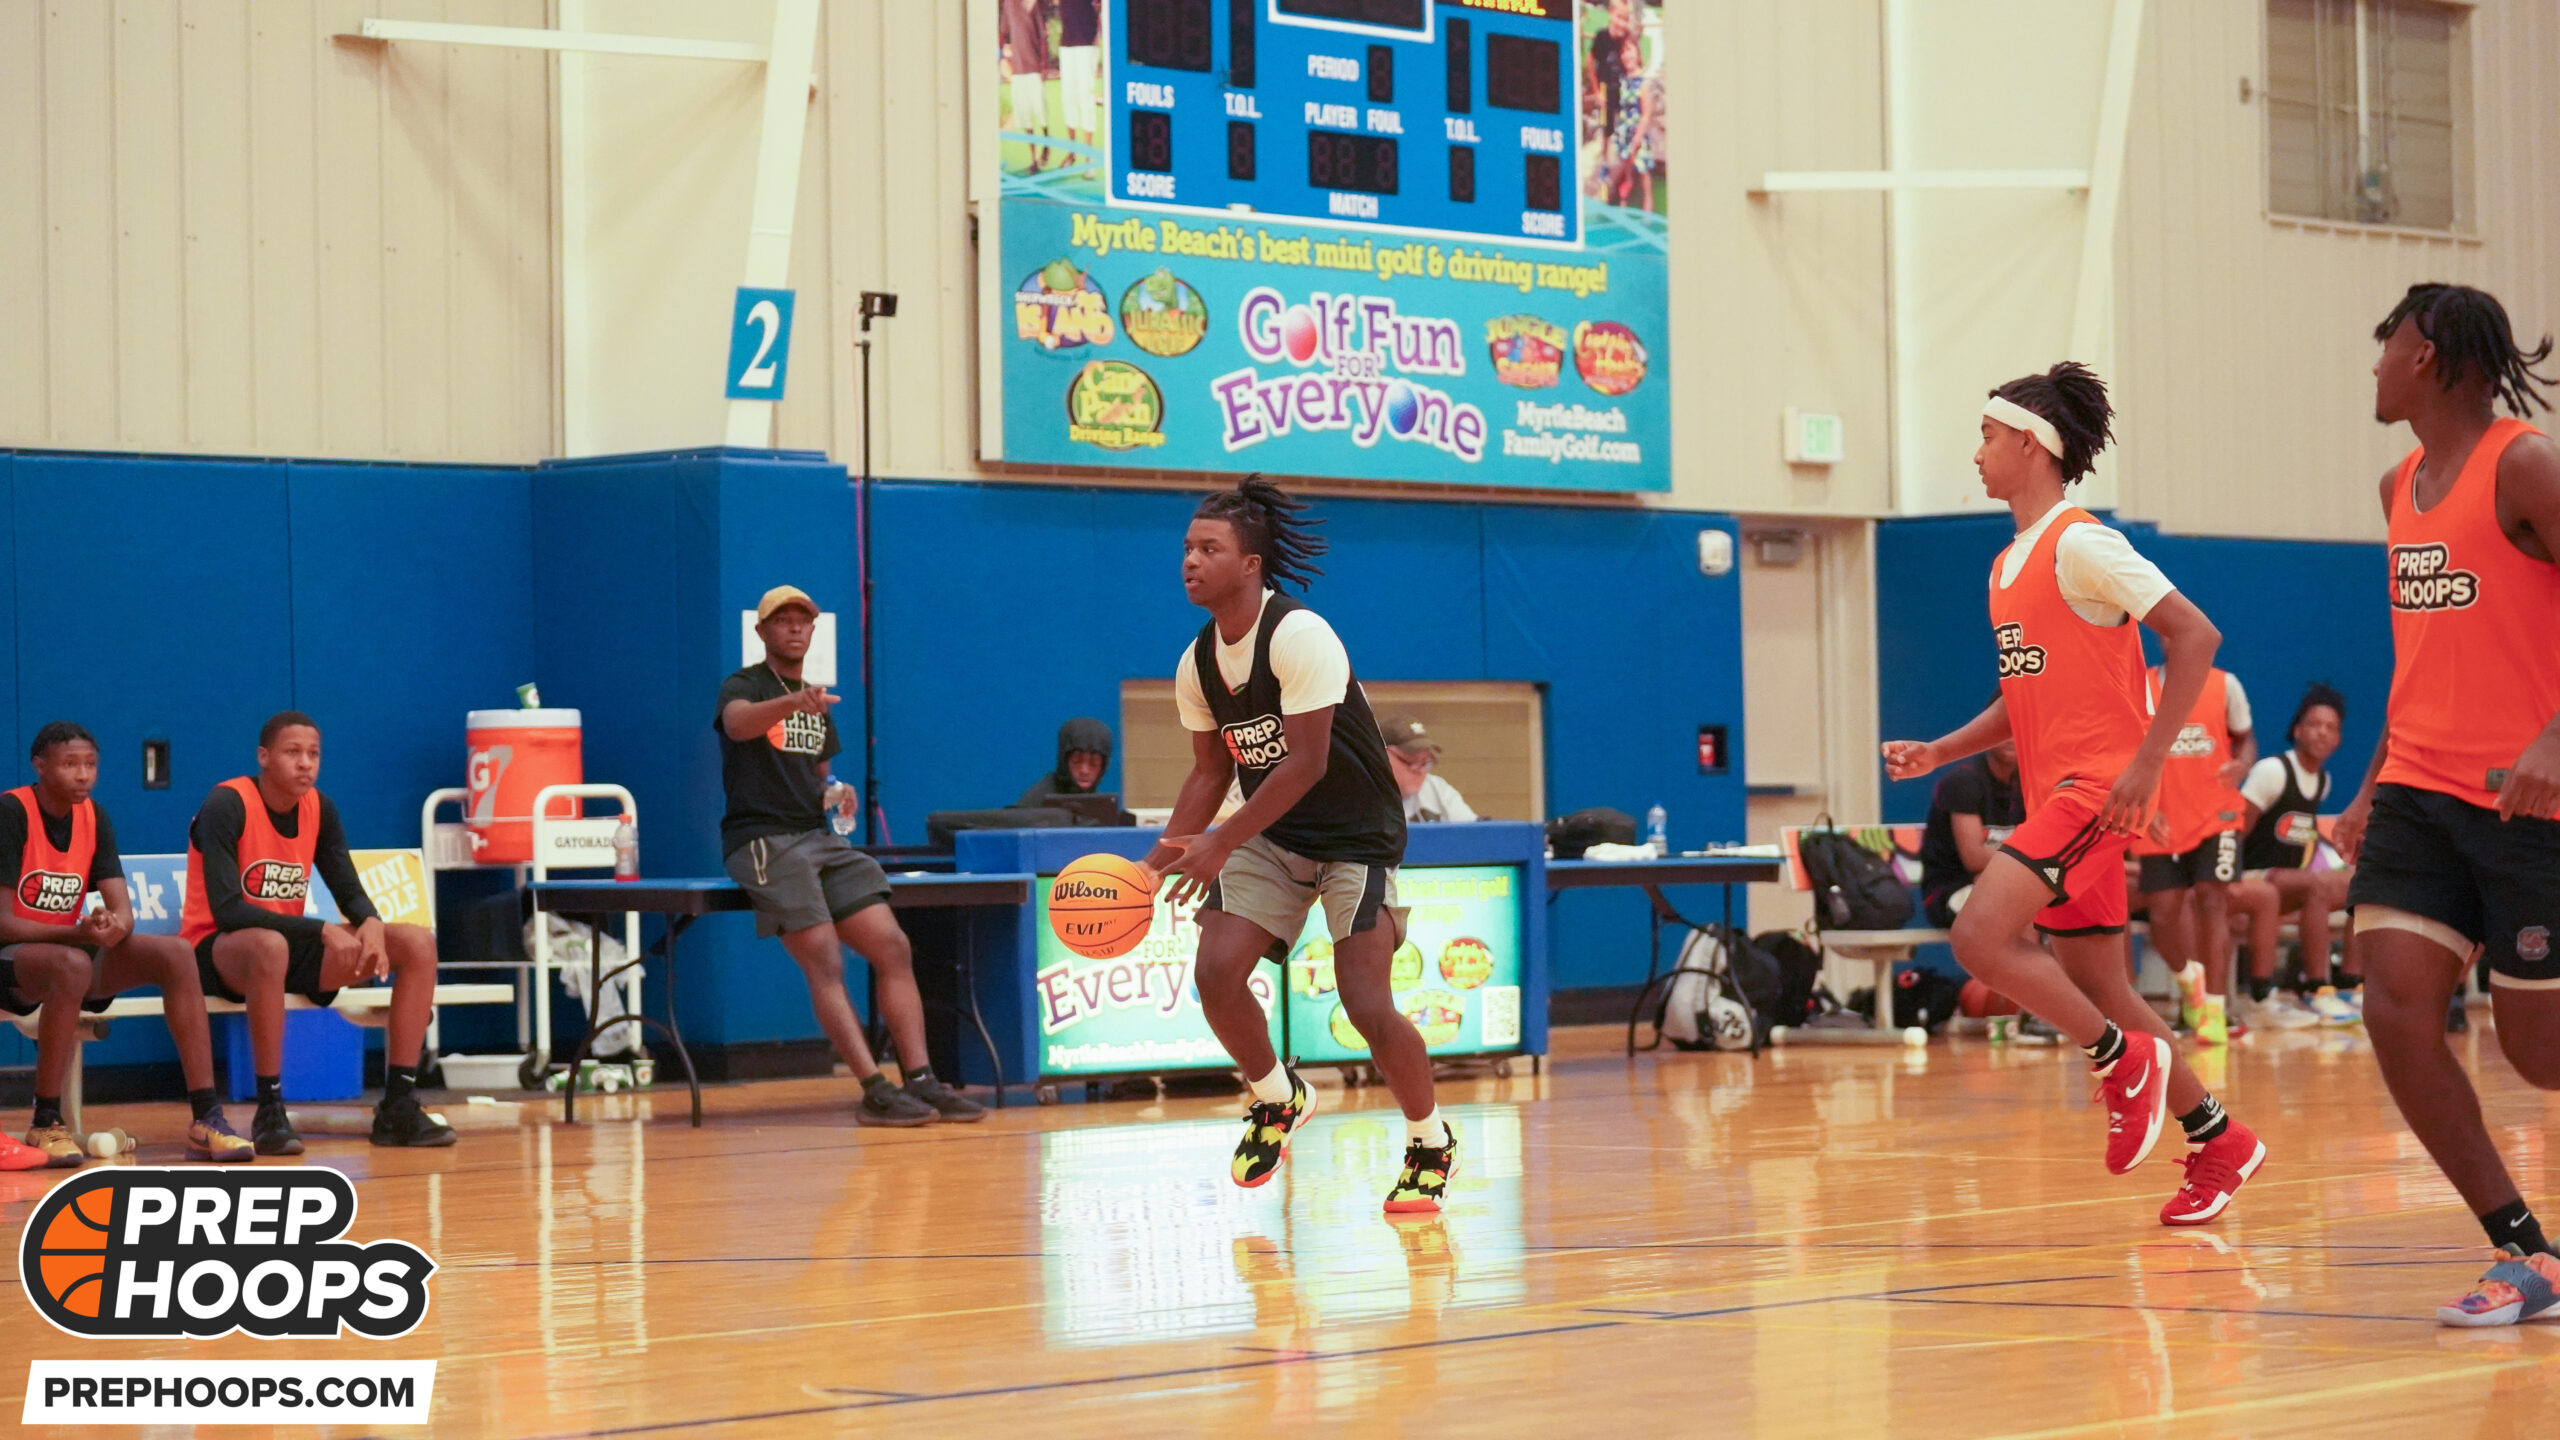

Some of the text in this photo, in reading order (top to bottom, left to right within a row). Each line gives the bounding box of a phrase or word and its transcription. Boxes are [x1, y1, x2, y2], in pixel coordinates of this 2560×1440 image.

[1307, 54, 1360, 82] PERIOD
[1126, 81, 1175, 108] FOULS
[1304, 101, 1404, 134] PLAYER FOUL
[1520, 126, 1564, 152] FOULS
[1126, 172, 1176, 199] SCORE
[1328, 192, 1379, 218] MATCH
[1521, 211, 1565, 237] SCORE
[1071, 213, 1608, 298] Myrtle Beach's best mini golf & driving range!
[738, 300, 780, 388] 2
[1245, 293, 1460, 369] Golf Fun
[1337, 355, 1376, 377] FOR
[1217, 374, 1481, 455] Everyone
[1516, 400, 1627, 433] MyrtleBeach
[1503, 428, 1642, 464] FamilyGolf.com
[1806, 417, 1833, 454] EXIT
[2397, 550, 2443, 576] PREP
[2398, 577, 2471, 605] HOOPS
[1998, 650, 2041, 674] OOPS
[785, 731, 823, 749] HOOP
[1233, 720, 1277, 746] PREP
[1240, 736, 1289, 764] HOO
[42, 875, 81, 894] PREP
[1054, 880, 1118, 901] Wilson
[1479, 875, 1510, 902] golf
[36, 893, 79, 910] HOOP
[374, 882, 419, 923] OLF
[1143, 940, 1177, 959] FOR
